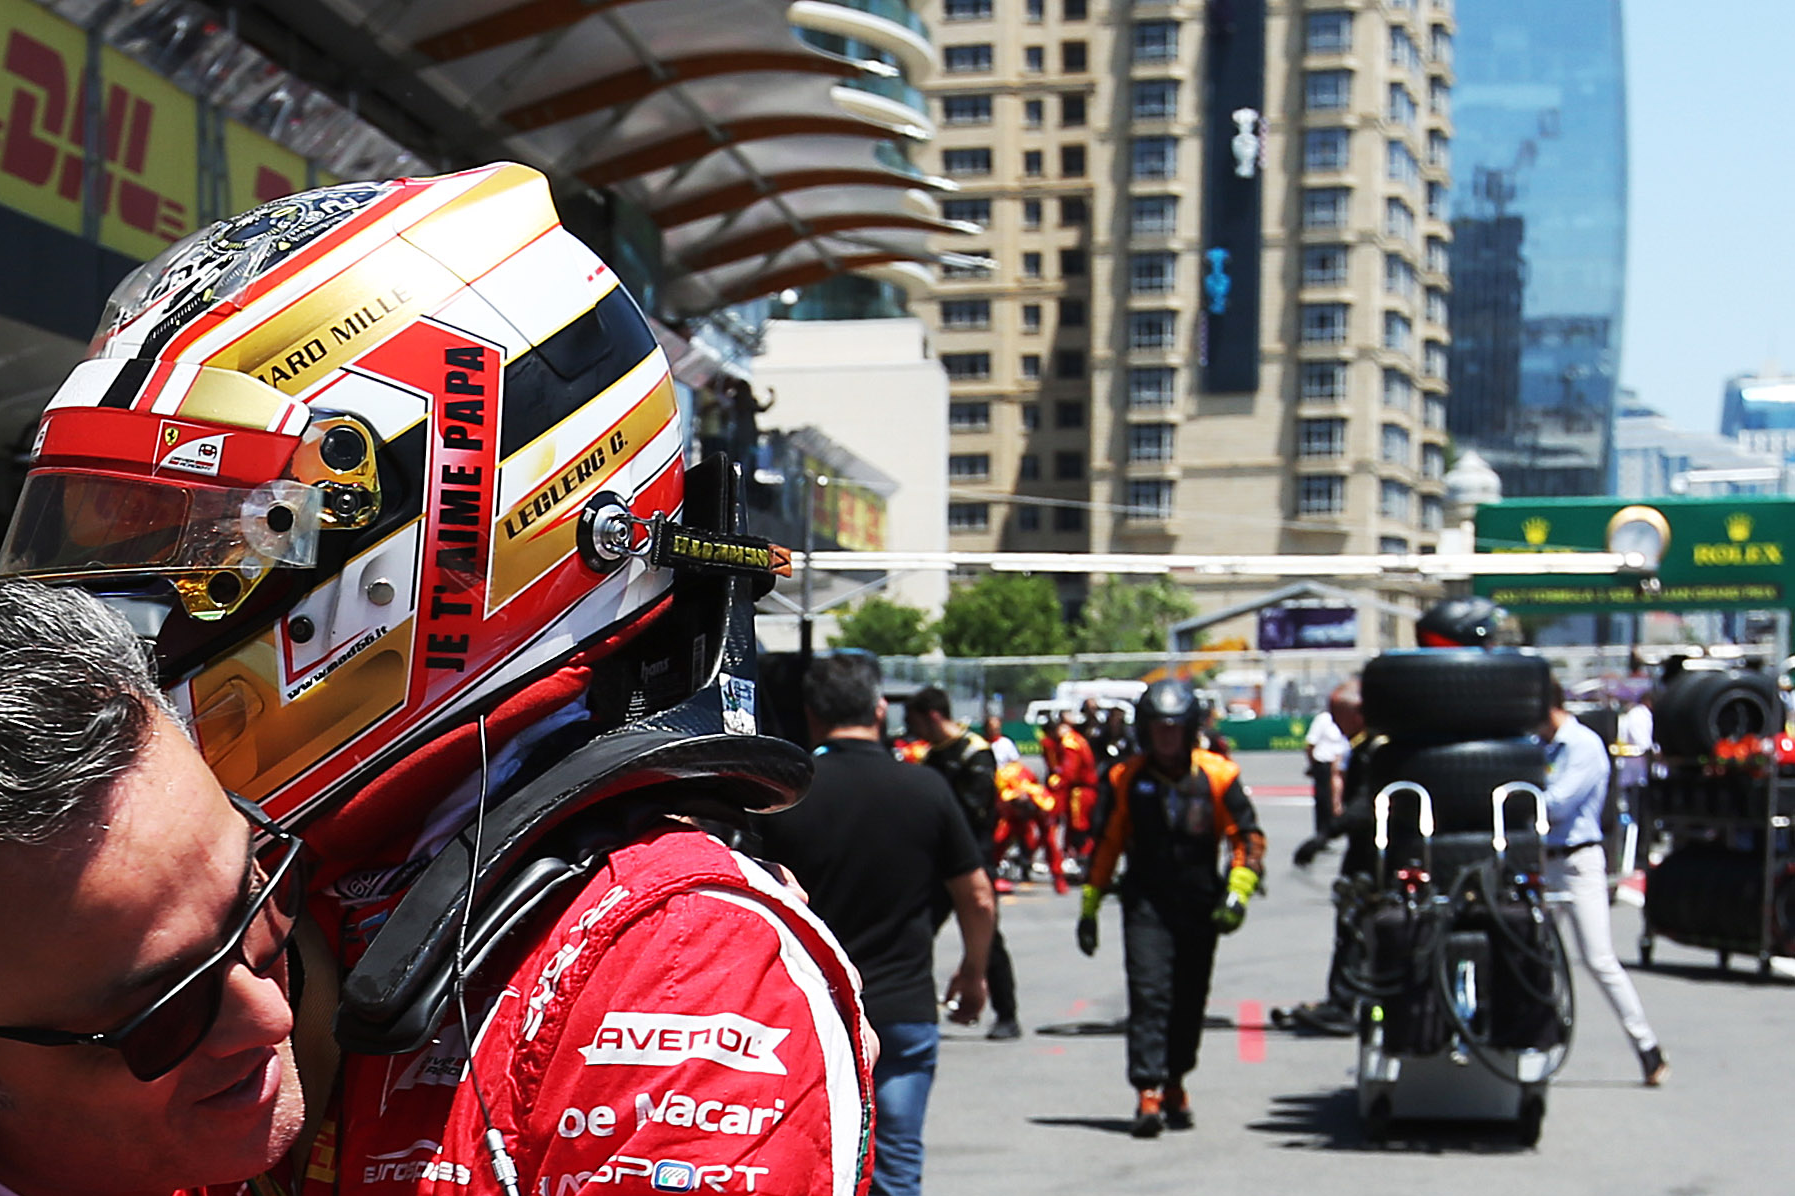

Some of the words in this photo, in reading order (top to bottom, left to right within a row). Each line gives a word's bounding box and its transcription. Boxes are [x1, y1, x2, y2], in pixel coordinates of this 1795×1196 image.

[1, 28, 161, 234] DHL
[329, 285, 413, 346] MILLE
[443, 346, 485, 451] PAPA
[504, 446, 606, 540] LECLERC
[673, 535, 770, 567] SCHROTH
[1693, 543, 1784, 566] ROLEX
[424, 634, 470, 673] JE
[635, 1089, 786, 1136] Macari
